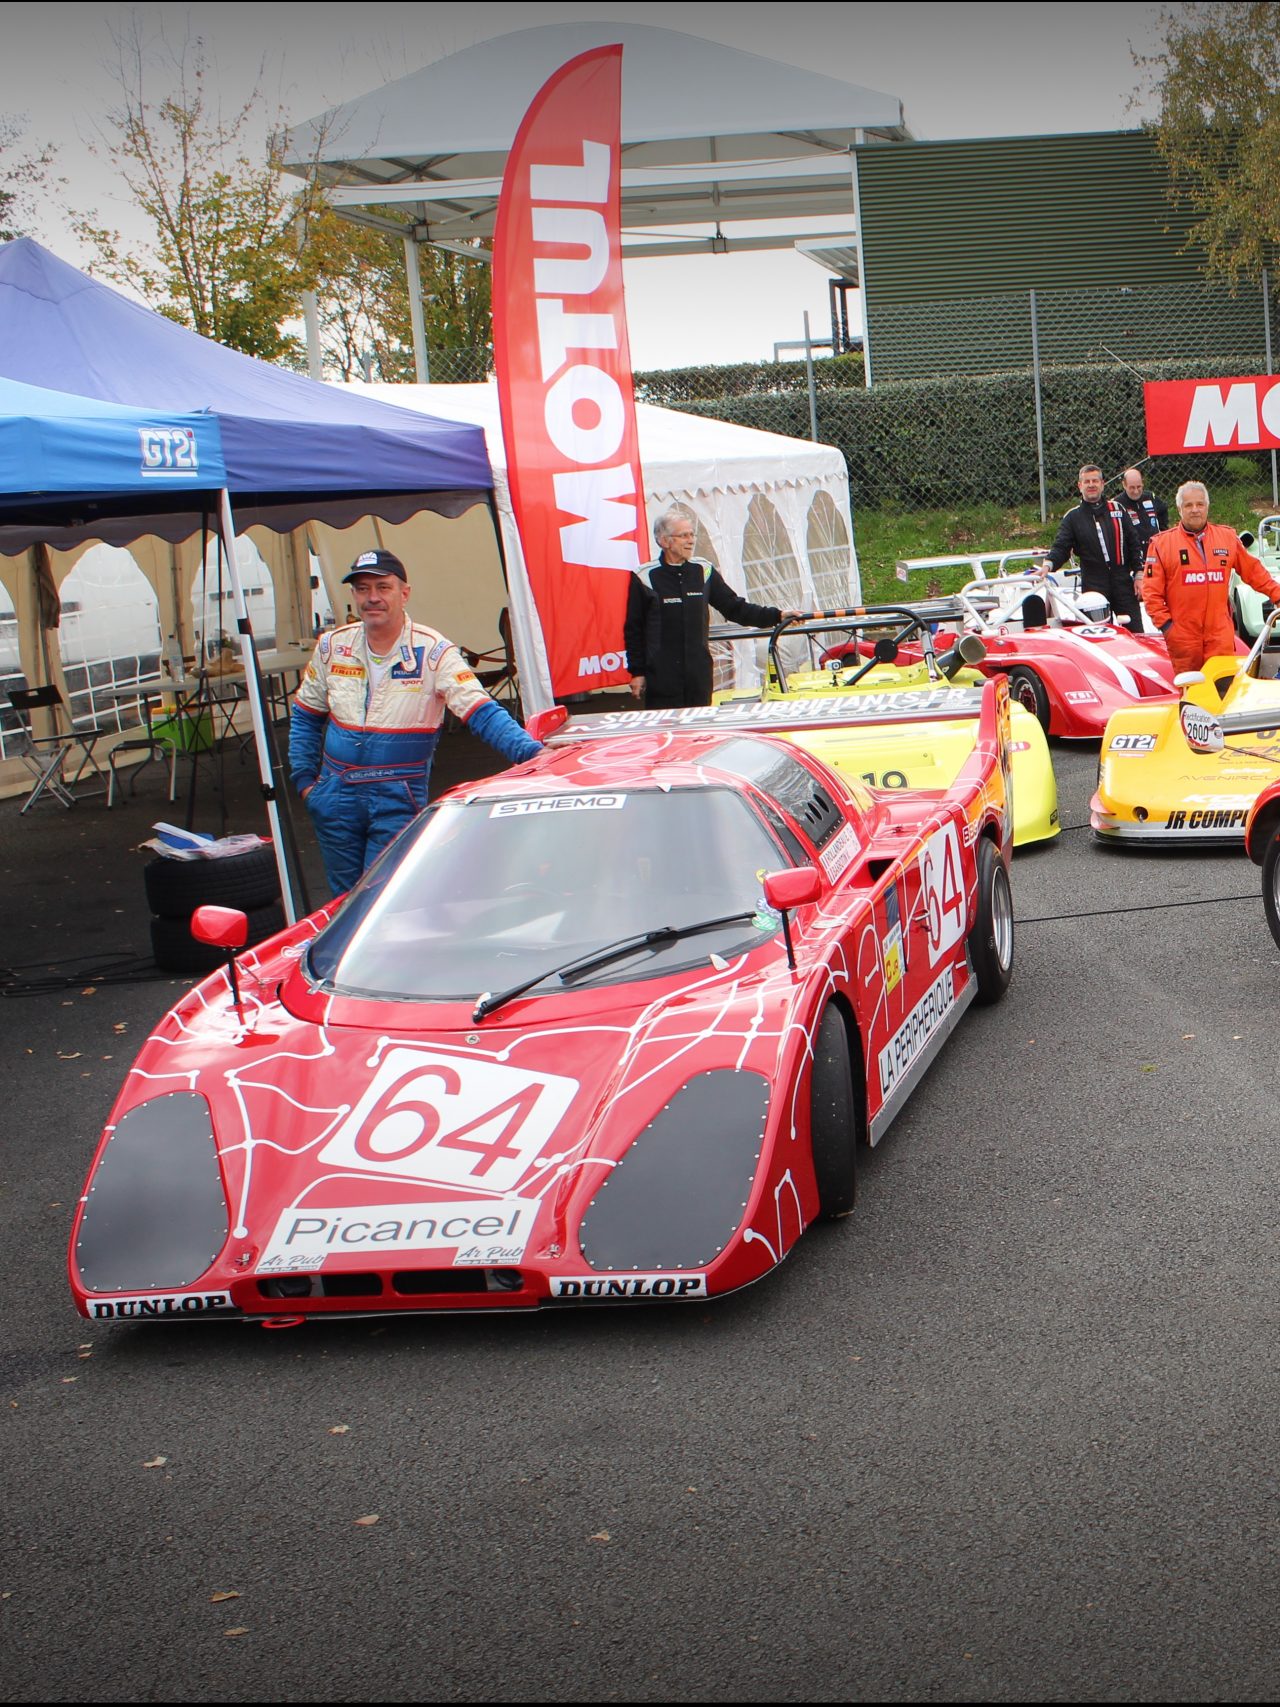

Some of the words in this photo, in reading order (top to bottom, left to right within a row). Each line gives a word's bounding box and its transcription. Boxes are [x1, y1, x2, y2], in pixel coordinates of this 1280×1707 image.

[530, 139, 640, 571] MOTUL
[139, 430, 198, 468] GT2i
[1185, 571, 1223, 583] MOTUL
[578, 651, 629, 676] MOT
[1110, 734, 1158, 749] GT2i
[499, 797, 617, 814] STHEMO
[1165, 811, 1187, 830] JR
[923, 833, 963, 951] 64
[880, 1051, 894, 1094] LA
[895, 970, 953, 1075] PERIPHERIQUE
[354, 1064, 545, 1177] 64
[285, 1210, 522, 1245] Picancel
[288, 1254, 325, 1267] Pub
[487, 1246, 524, 1258] Pub
[558, 1278, 701, 1297] DUNLOP
[94, 1295, 226, 1319] DUNLOP
